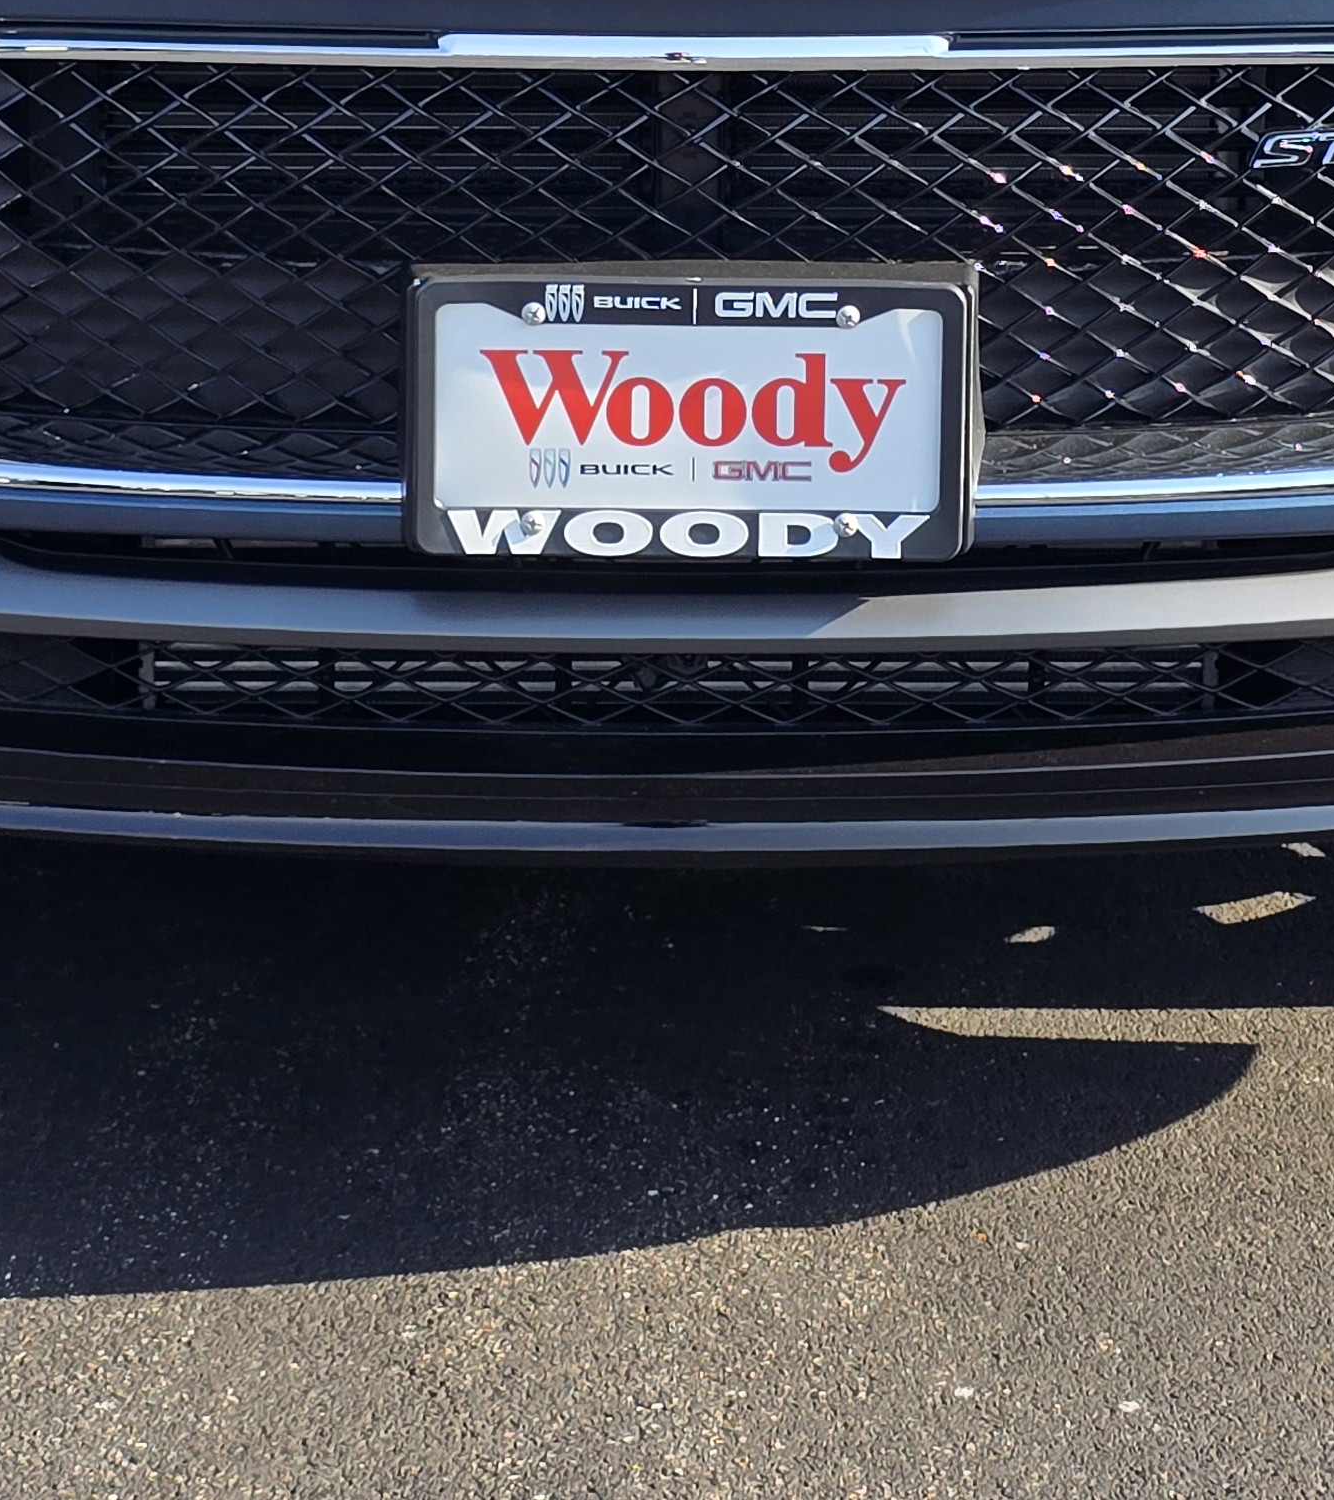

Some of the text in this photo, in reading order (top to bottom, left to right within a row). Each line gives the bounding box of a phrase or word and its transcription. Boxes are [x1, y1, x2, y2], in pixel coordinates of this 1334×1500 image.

[592, 291, 840, 320] BUICK GMC
[479, 348, 908, 474] Woody
[578, 460, 813, 482] BUICK GMC
[446, 509, 932, 560] WOODY
